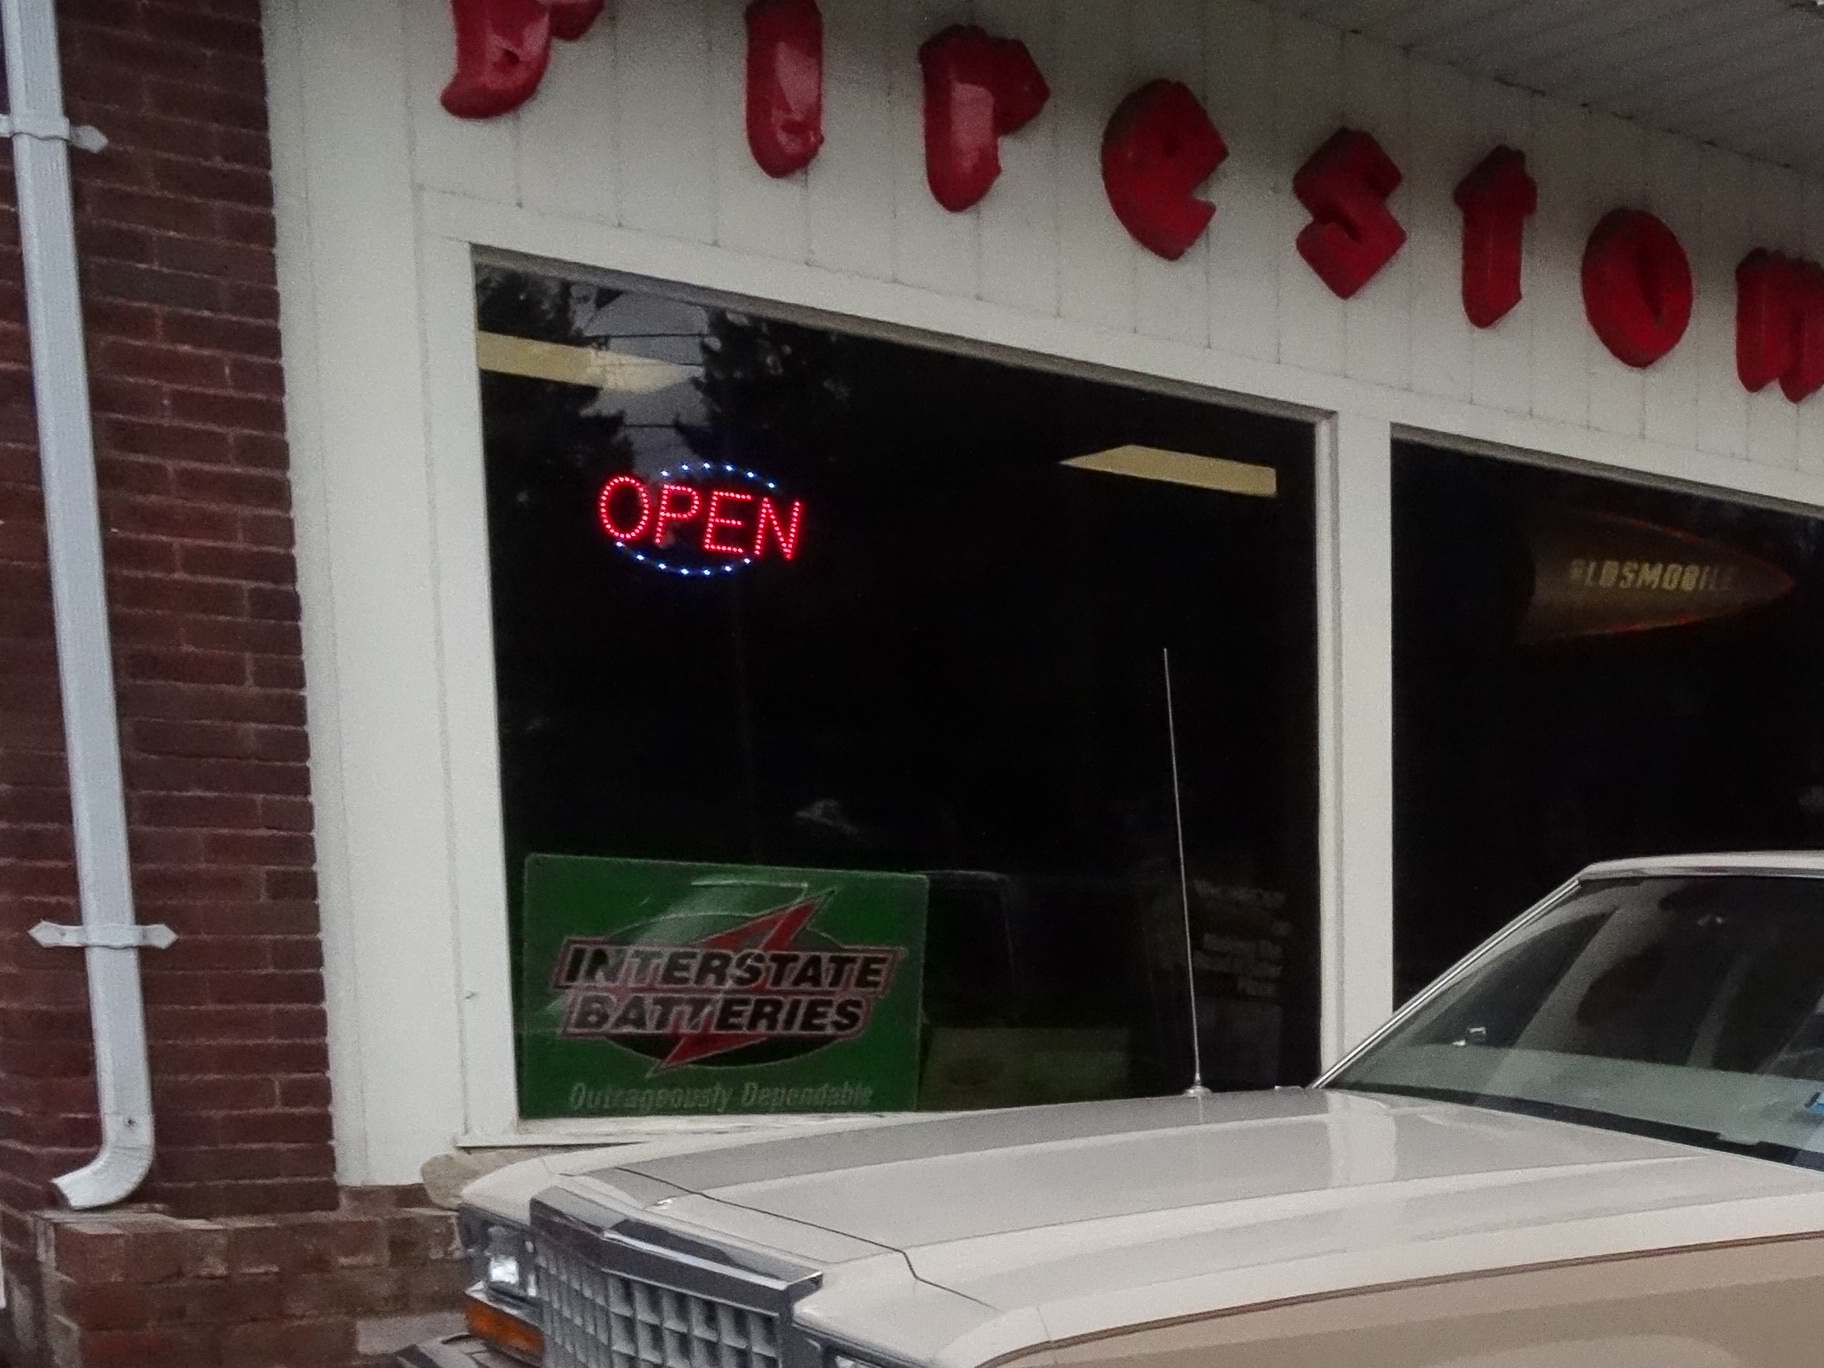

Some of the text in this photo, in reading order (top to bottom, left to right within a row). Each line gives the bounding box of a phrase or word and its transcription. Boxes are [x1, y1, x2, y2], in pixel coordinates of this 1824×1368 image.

[600, 475, 801, 559] OPEN
[560, 946, 892, 990] INTERSTATE
[570, 994, 868, 1035] BATTERIES
[568, 1080, 874, 1113] Outrageously Dependable
